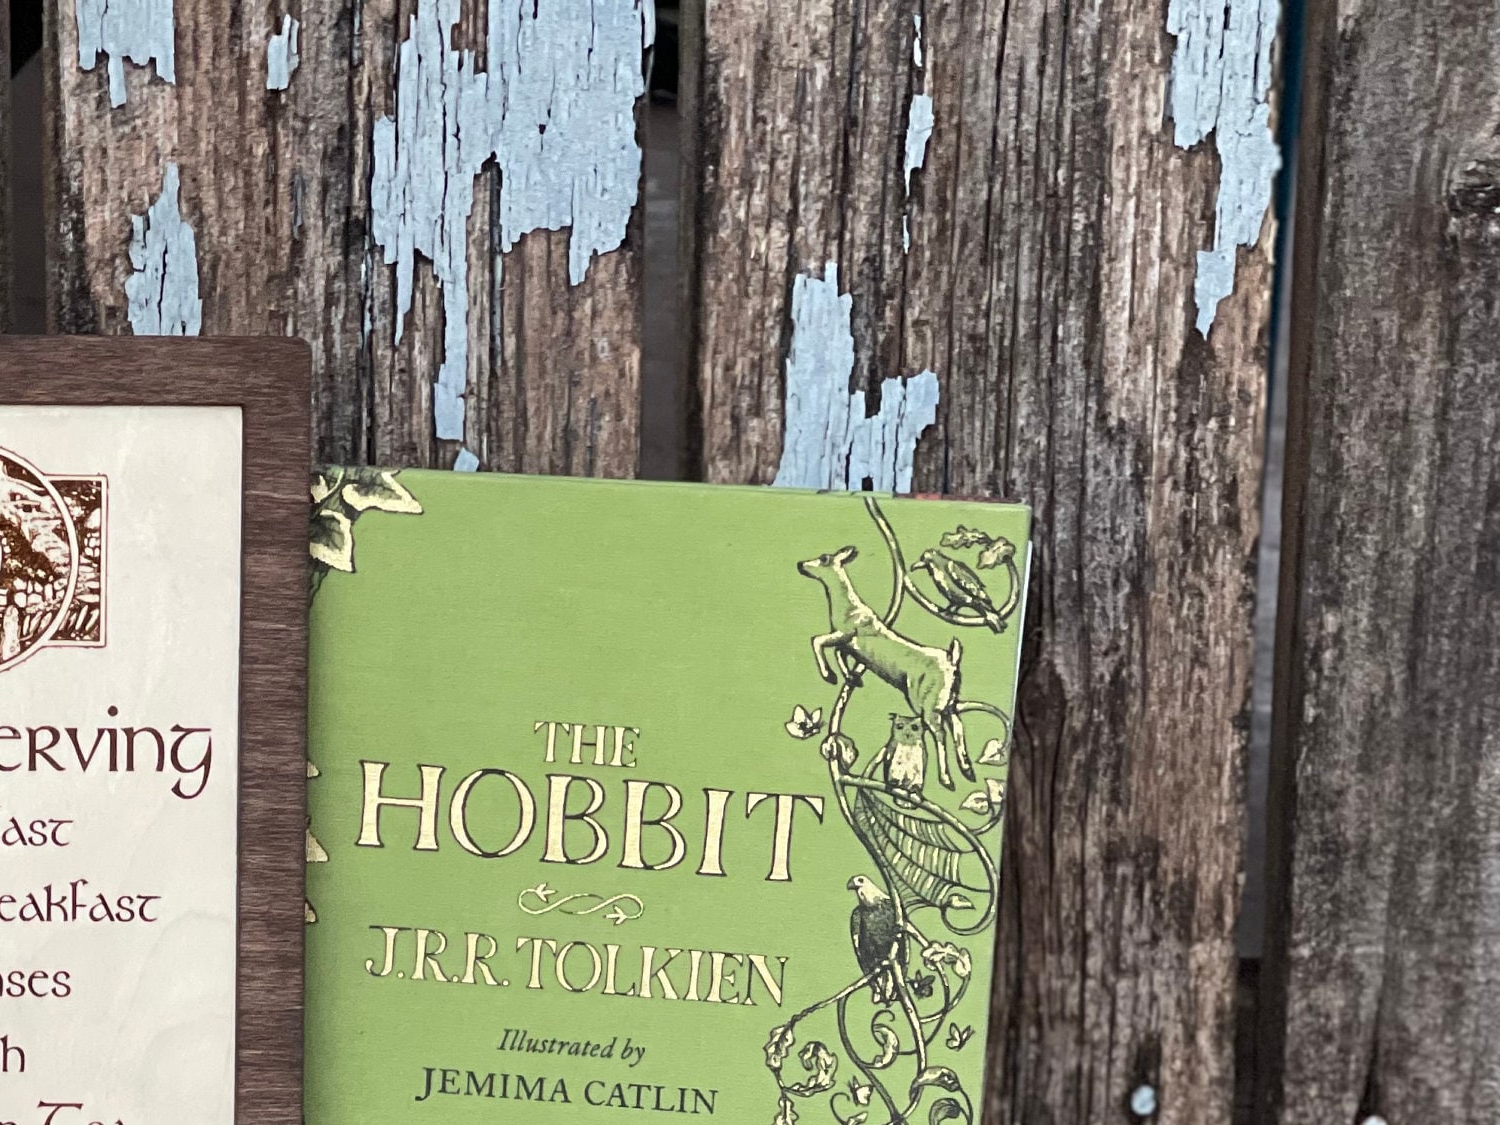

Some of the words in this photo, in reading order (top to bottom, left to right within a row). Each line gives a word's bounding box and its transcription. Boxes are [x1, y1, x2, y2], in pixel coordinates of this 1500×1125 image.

[534, 720, 641, 769] THE
[355, 759, 826, 883] HOBBIT
[363, 923, 511, 988] J.R.R.
[516, 936, 790, 1009] TOLKIEN
[496, 1028, 617, 1062] Illustrated
[620, 1039, 647, 1069] by
[415, 1066, 573, 1108] JEMIMA
[583, 1079, 719, 1117] CATLIN
